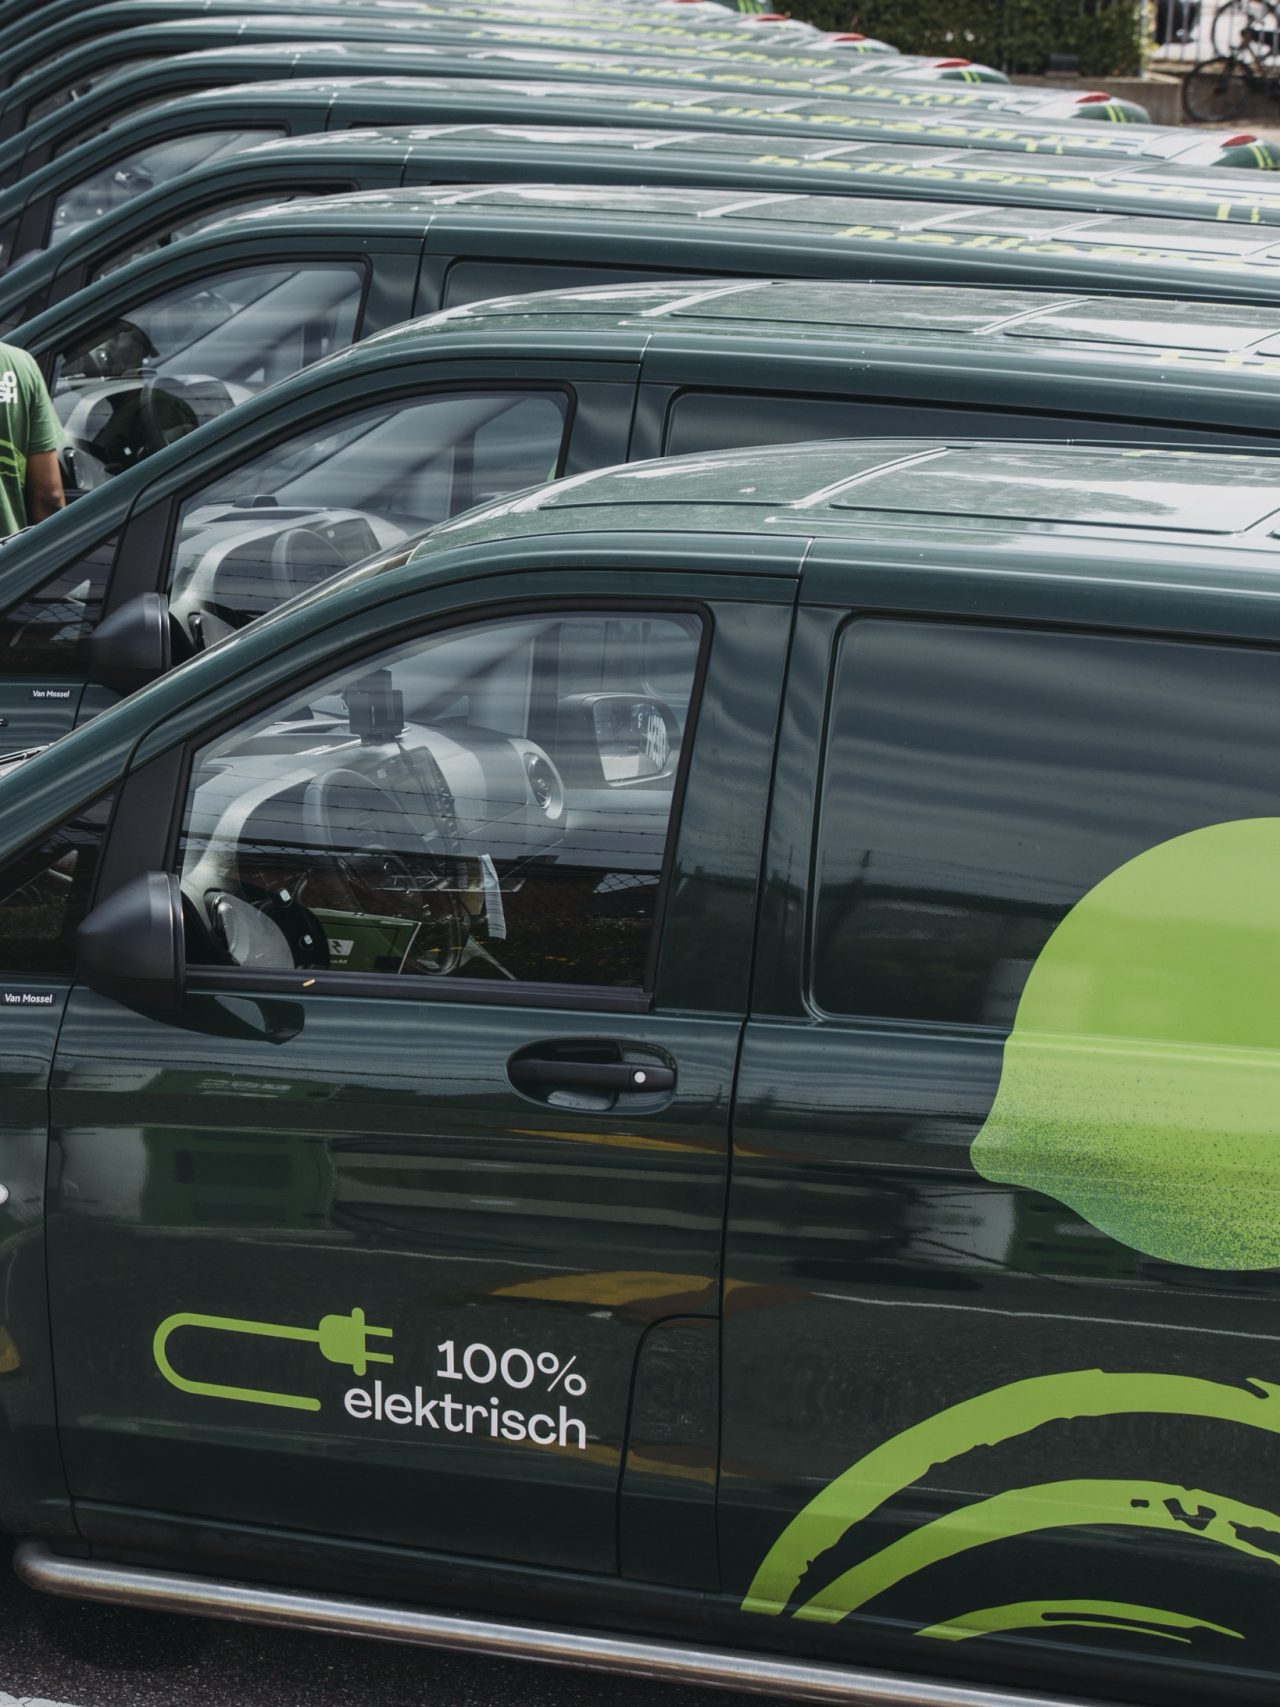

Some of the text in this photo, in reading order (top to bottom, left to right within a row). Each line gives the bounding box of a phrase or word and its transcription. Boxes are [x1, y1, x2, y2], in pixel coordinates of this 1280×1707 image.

[32, 689, 71, 698] Van Mossel
[4, 993, 53, 1004] Van Mossel
[435, 1339, 588, 1397] 100%
[343, 1379, 588, 1450] elektrisch
